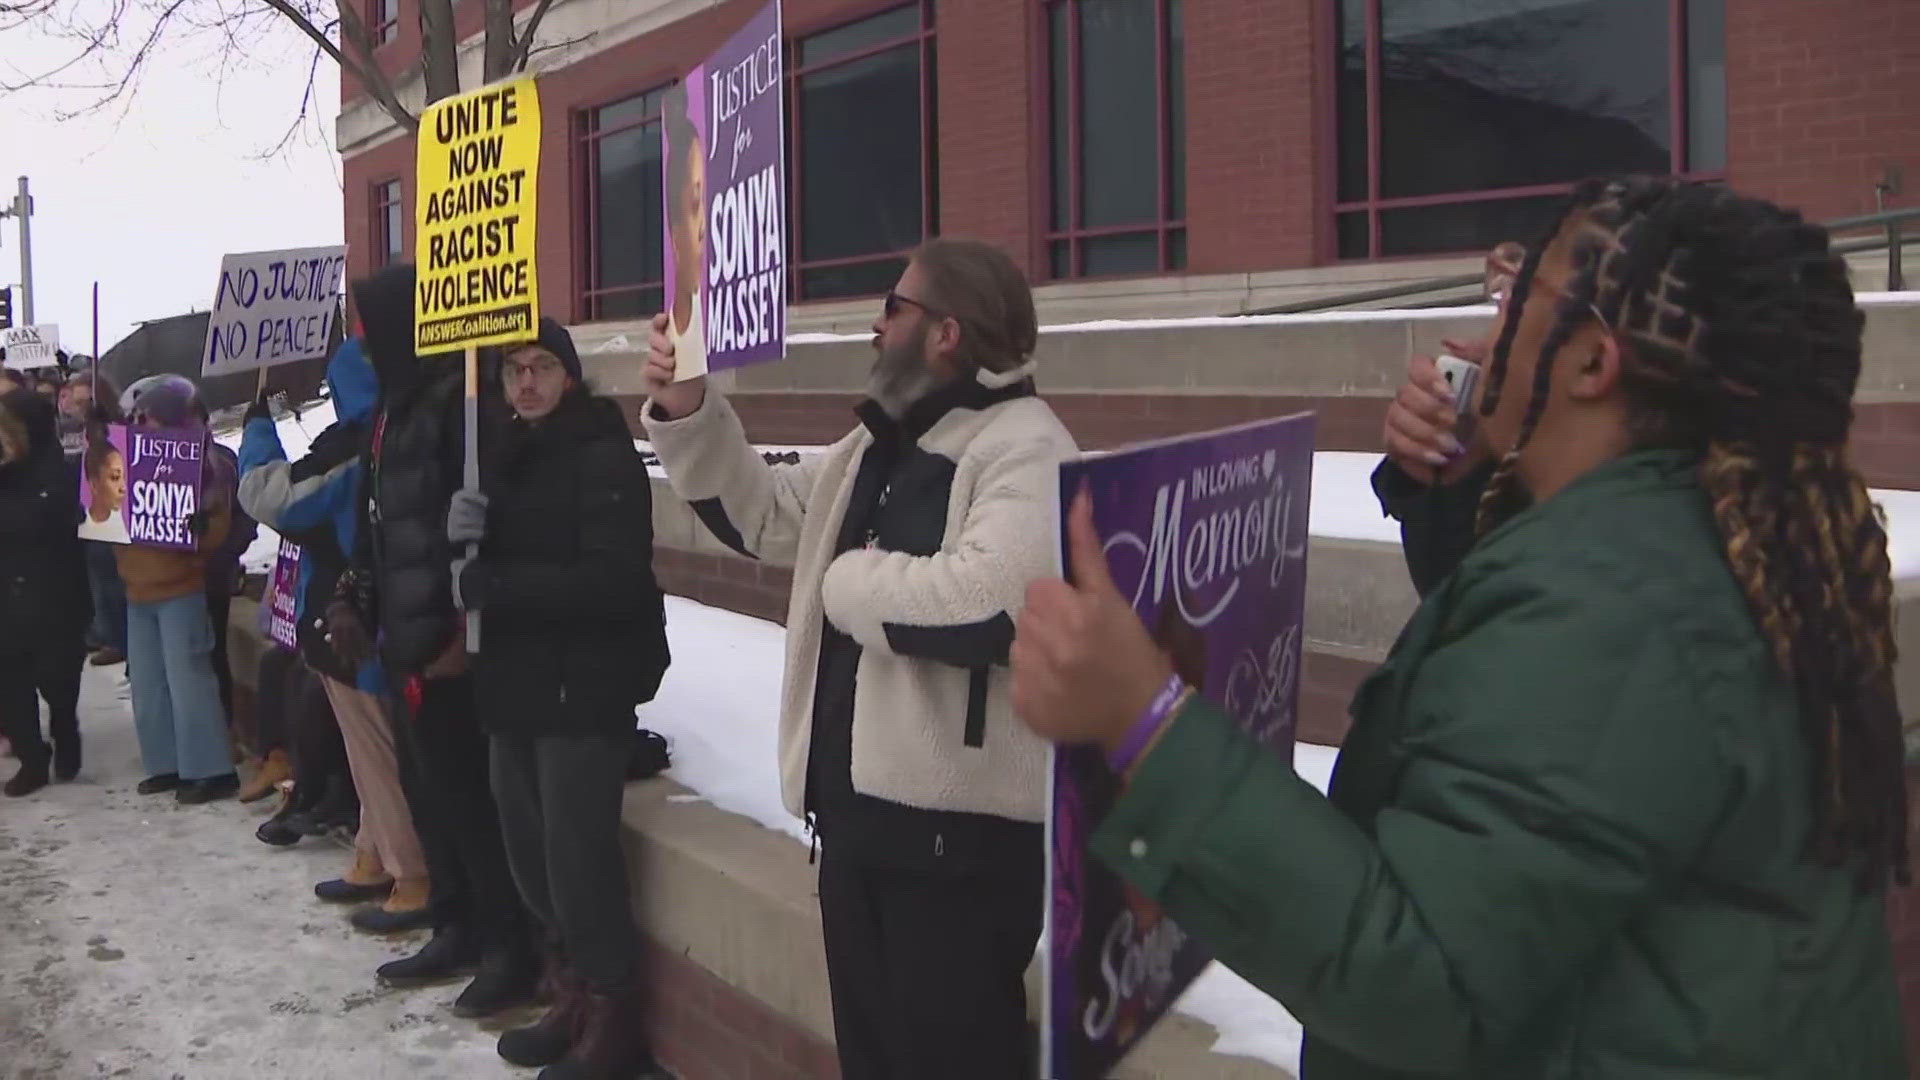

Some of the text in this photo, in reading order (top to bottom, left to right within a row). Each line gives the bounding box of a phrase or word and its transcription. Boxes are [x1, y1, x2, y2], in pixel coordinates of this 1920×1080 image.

[436, 86, 518, 145] UNITE
[709, 33, 778, 160] JUSTICE
[449, 134, 504, 182] NOW
[731, 114, 754, 180] for
[425, 169, 526, 225] AGAINST
[429, 214, 520, 272] RACIST
[709, 164, 781, 288] SONYA
[217, 255, 345, 312] NO JUSTICE
[419, 258, 529, 316] VIOLENCE
[707, 267, 783, 356] MASSEY
[210, 311, 329, 366] NO PEACE!
[131, 433, 201, 468] JUSTICE
[153, 457, 175, 481] for
[1192, 454, 1261, 500] IN LOVING
[132, 480, 196, 519] SONYA
[1104, 472, 1304, 627] Memory
